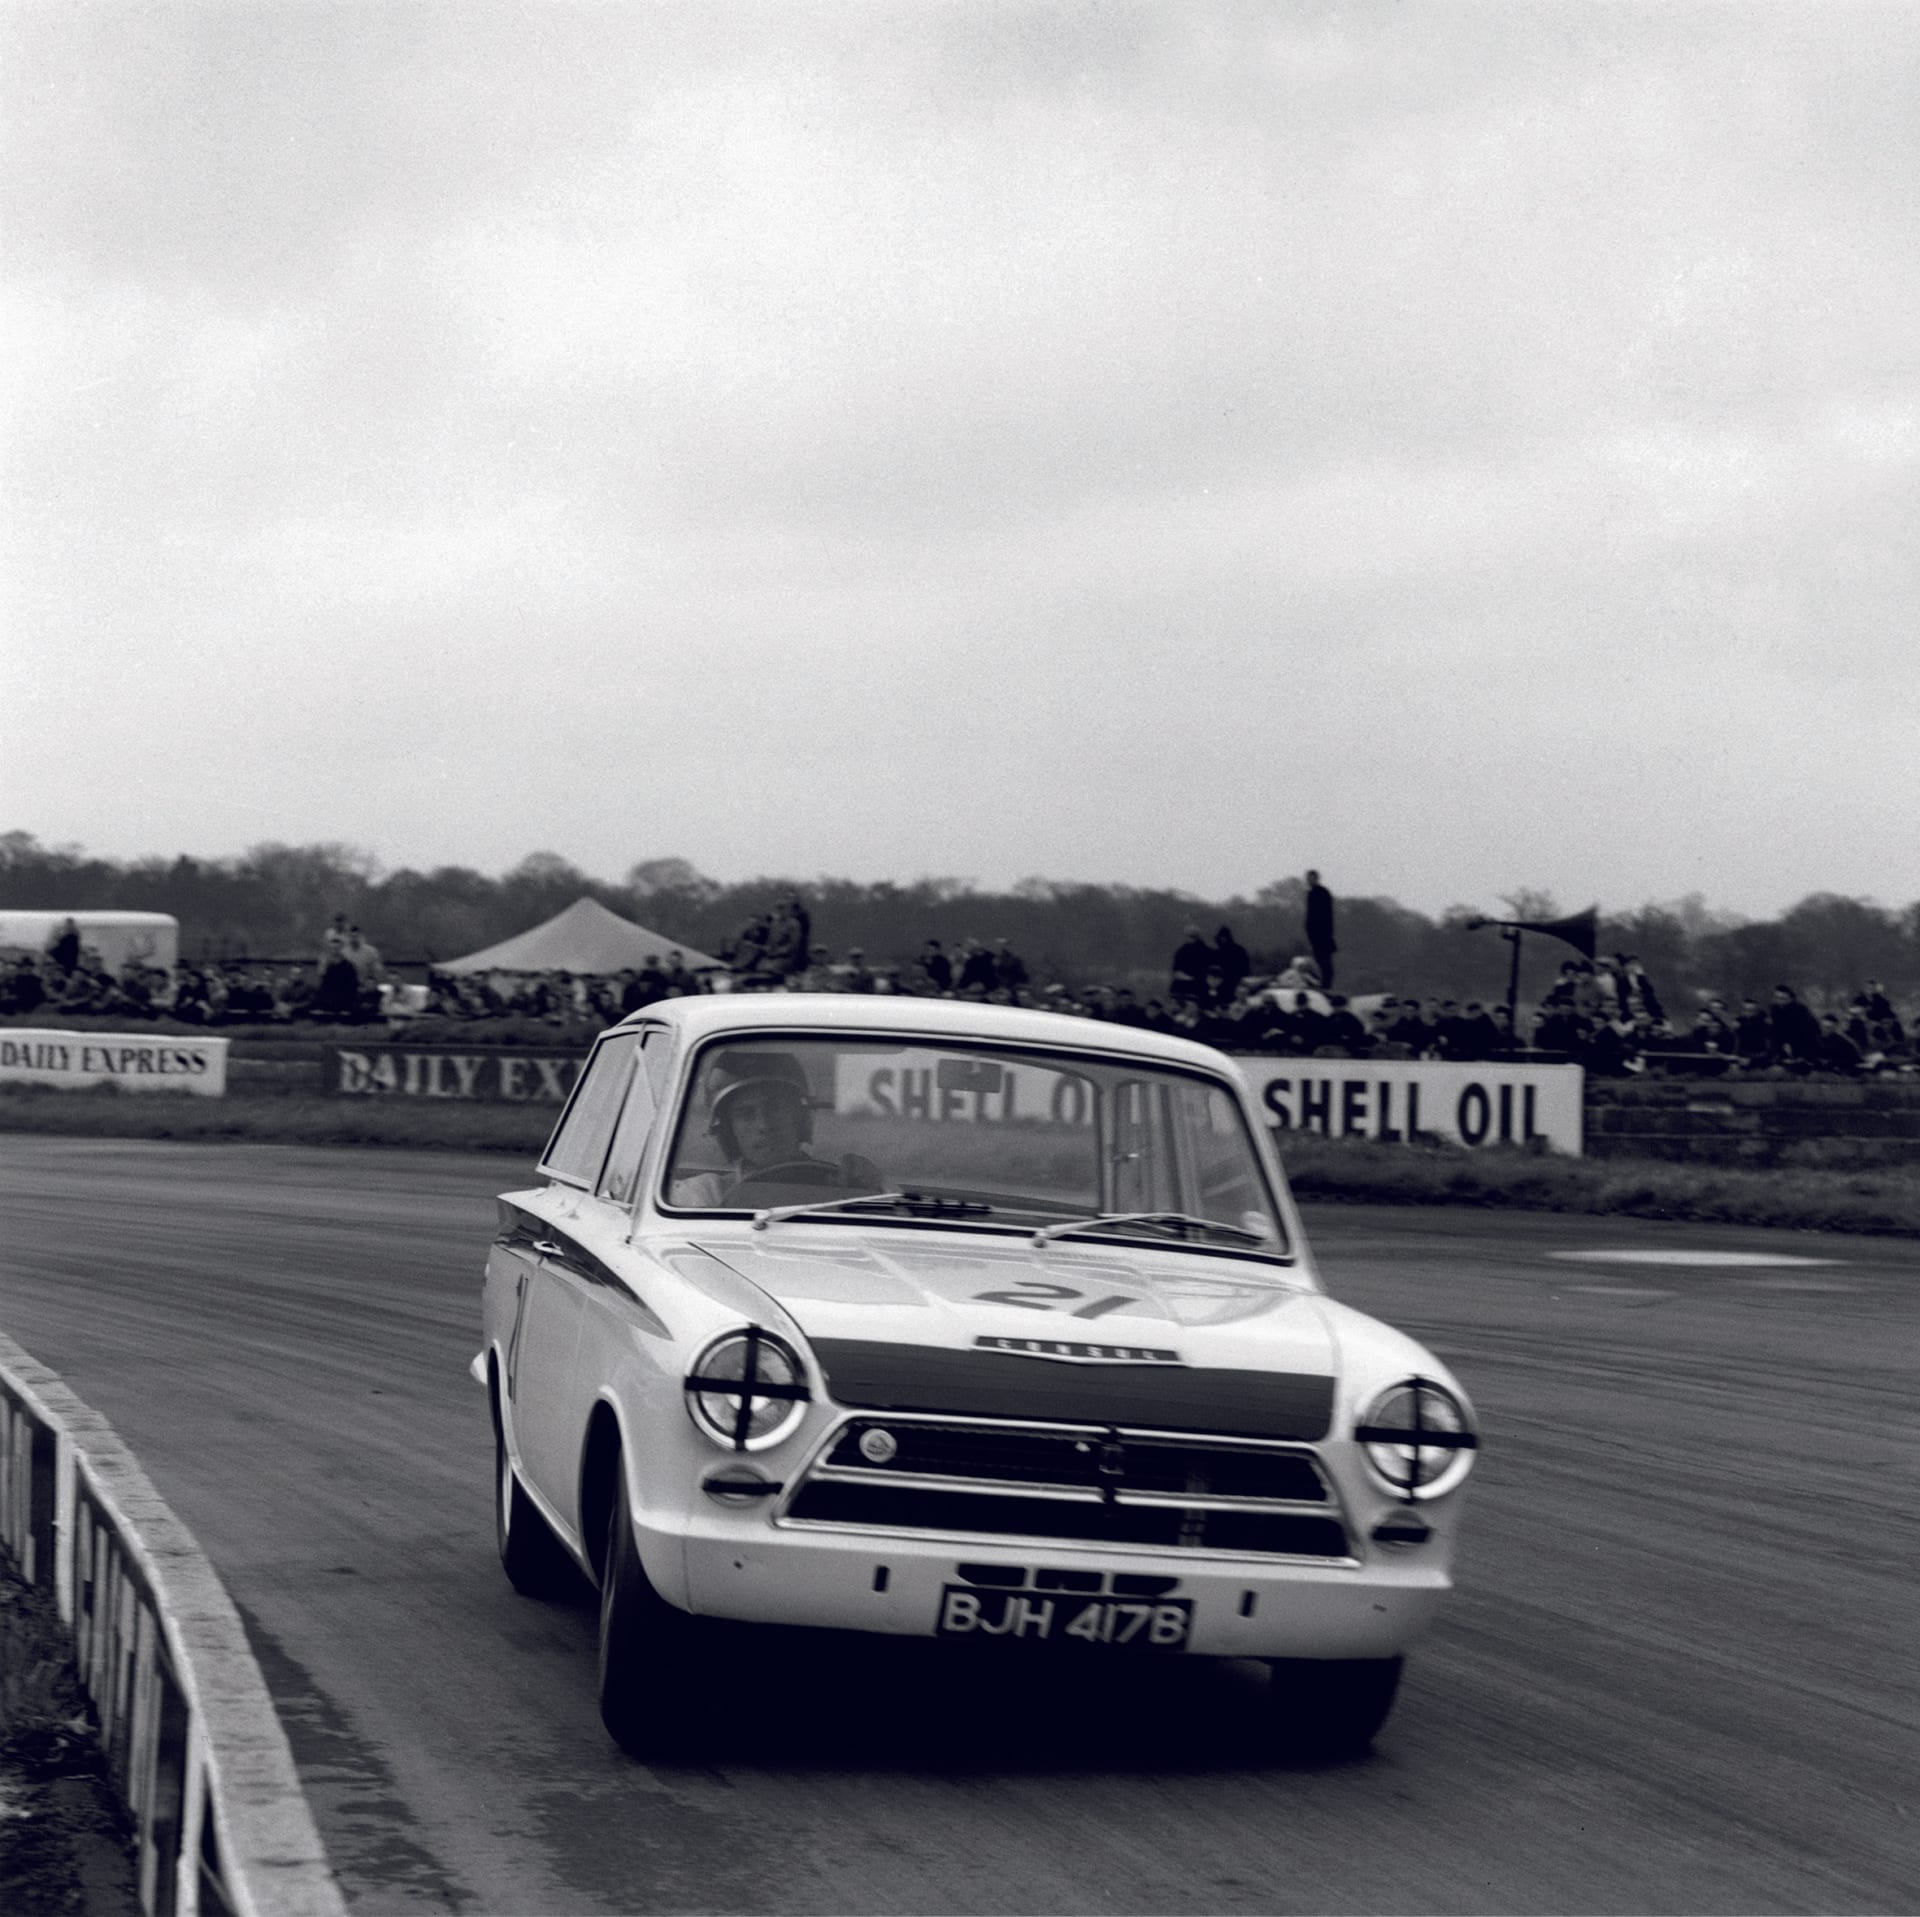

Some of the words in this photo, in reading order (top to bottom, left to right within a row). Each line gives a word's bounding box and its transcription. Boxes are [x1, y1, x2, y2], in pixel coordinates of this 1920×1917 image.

[1, 1041, 70, 1071] DAILY
[81, 1046, 206, 1074] EXPRESS
[338, 1050, 486, 1098] DAILY
[499, 1057, 587, 1101] EX
[1262, 1078, 1435, 1144] SHELL
[1457, 1082, 1549, 1147] OIL
[971, 1281, 1138, 1320] 21
[942, 1591, 1056, 1639] BJH
[1064, 1603, 1190, 1645] 417B
